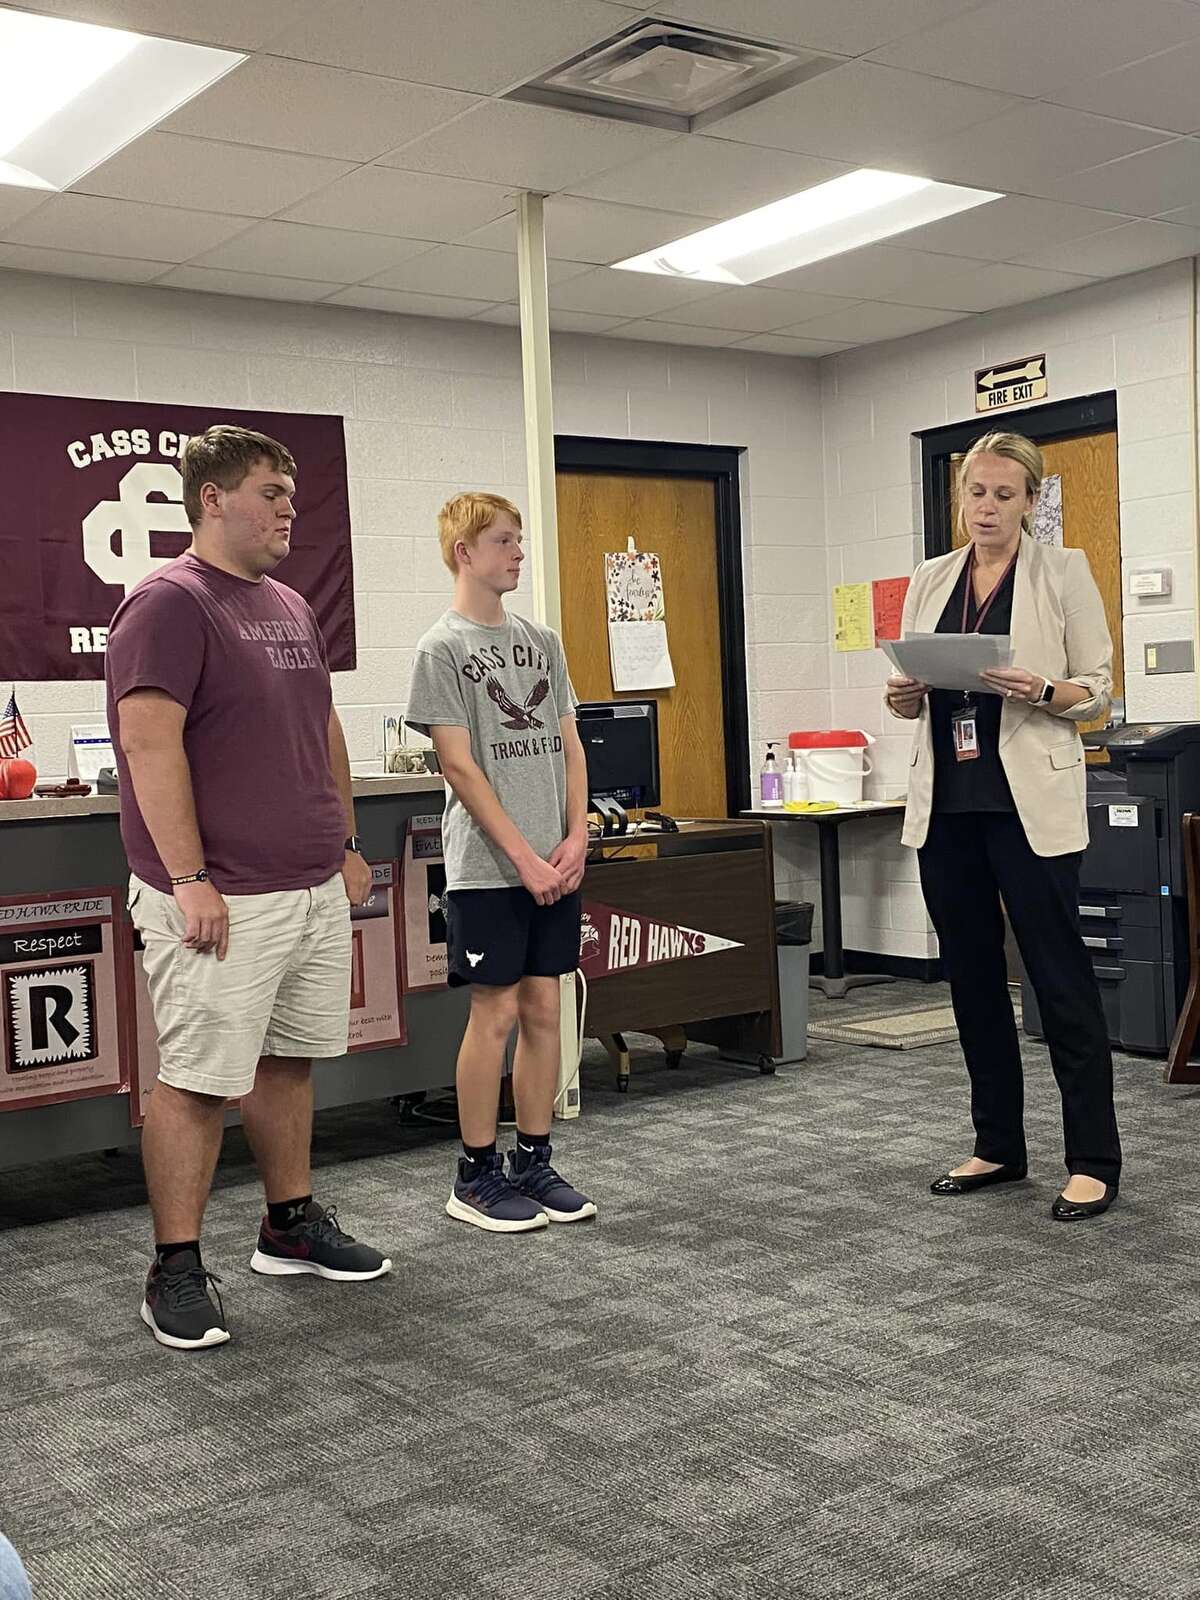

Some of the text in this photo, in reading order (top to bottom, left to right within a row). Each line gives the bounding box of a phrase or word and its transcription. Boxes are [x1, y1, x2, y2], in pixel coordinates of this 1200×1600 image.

[988, 383, 1033, 406] FIRE EXIT
[67, 428, 187, 469] CASS CI
[69, 627, 109, 653] RE
[238, 620, 311, 641] AMERICA
[265, 646, 317, 670] EAGLE
[462, 645, 506, 683] CASS
[490, 740, 531, 760] TRACK
[532, 738, 541, 756] &
[371, 867, 391, 879] IDE
[0, 900, 103, 920] ED HAWK PRIDE
[13, 932, 82, 956] Respect
[608, 914, 706, 970] RED HAWKS
[29, 985, 80, 1051] R
